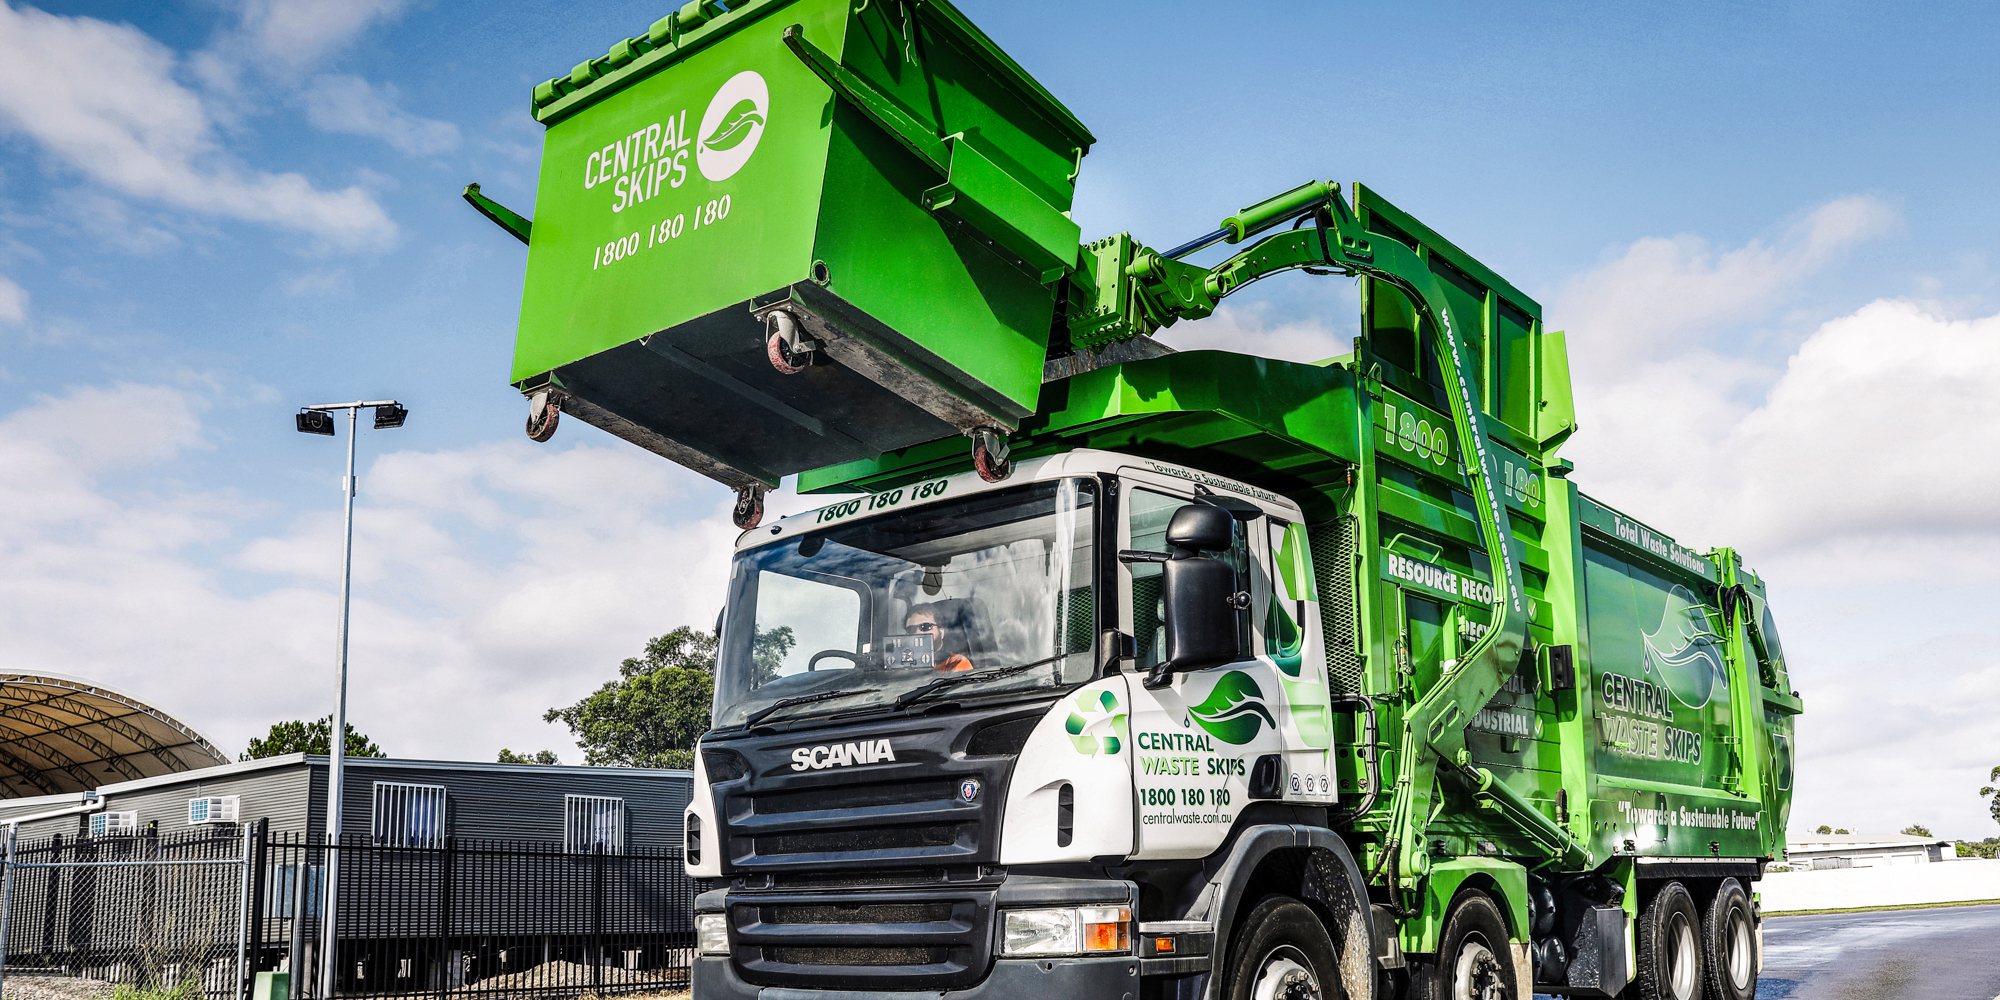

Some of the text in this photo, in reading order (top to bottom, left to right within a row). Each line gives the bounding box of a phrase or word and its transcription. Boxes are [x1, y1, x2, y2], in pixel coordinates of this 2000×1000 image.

[584, 109, 691, 189] CENTRAL
[612, 149, 689, 213] SKIPS
[593, 194, 732, 270] 1800 180 180
[1384, 403, 1449, 466] 1800
[1504, 460, 1541, 508] 180
[1441, 307, 1521, 613] www.centralwaste.com.au
[816, 479, 949, 524] 1800 180 180
[1194, 473, 1201, 481] a
[1202, 474, 1251, 495] Sustainable
[1614, 516, 1705, 575] Total Waste Solutions
[1388, 553, 1458, 595] RESOURCE
[1601, 671, 1674, 723] CENTRAL
[790, 738, 896, 772] SCANIA
[1138, 732, 1215, 753] CENTRAL
[1601, 712, 1702, 766] WASTE SKIPS
[1139, 756, 1246, 777] WASTE SKIPS
[1140, 788, 1231, 807] 1800 180 180
[1143, 808, 1232, 825] centralwaste.com.au
[1670, 810, 1677, 827] a
[1679, 805, 1730, 829] Sustainable
